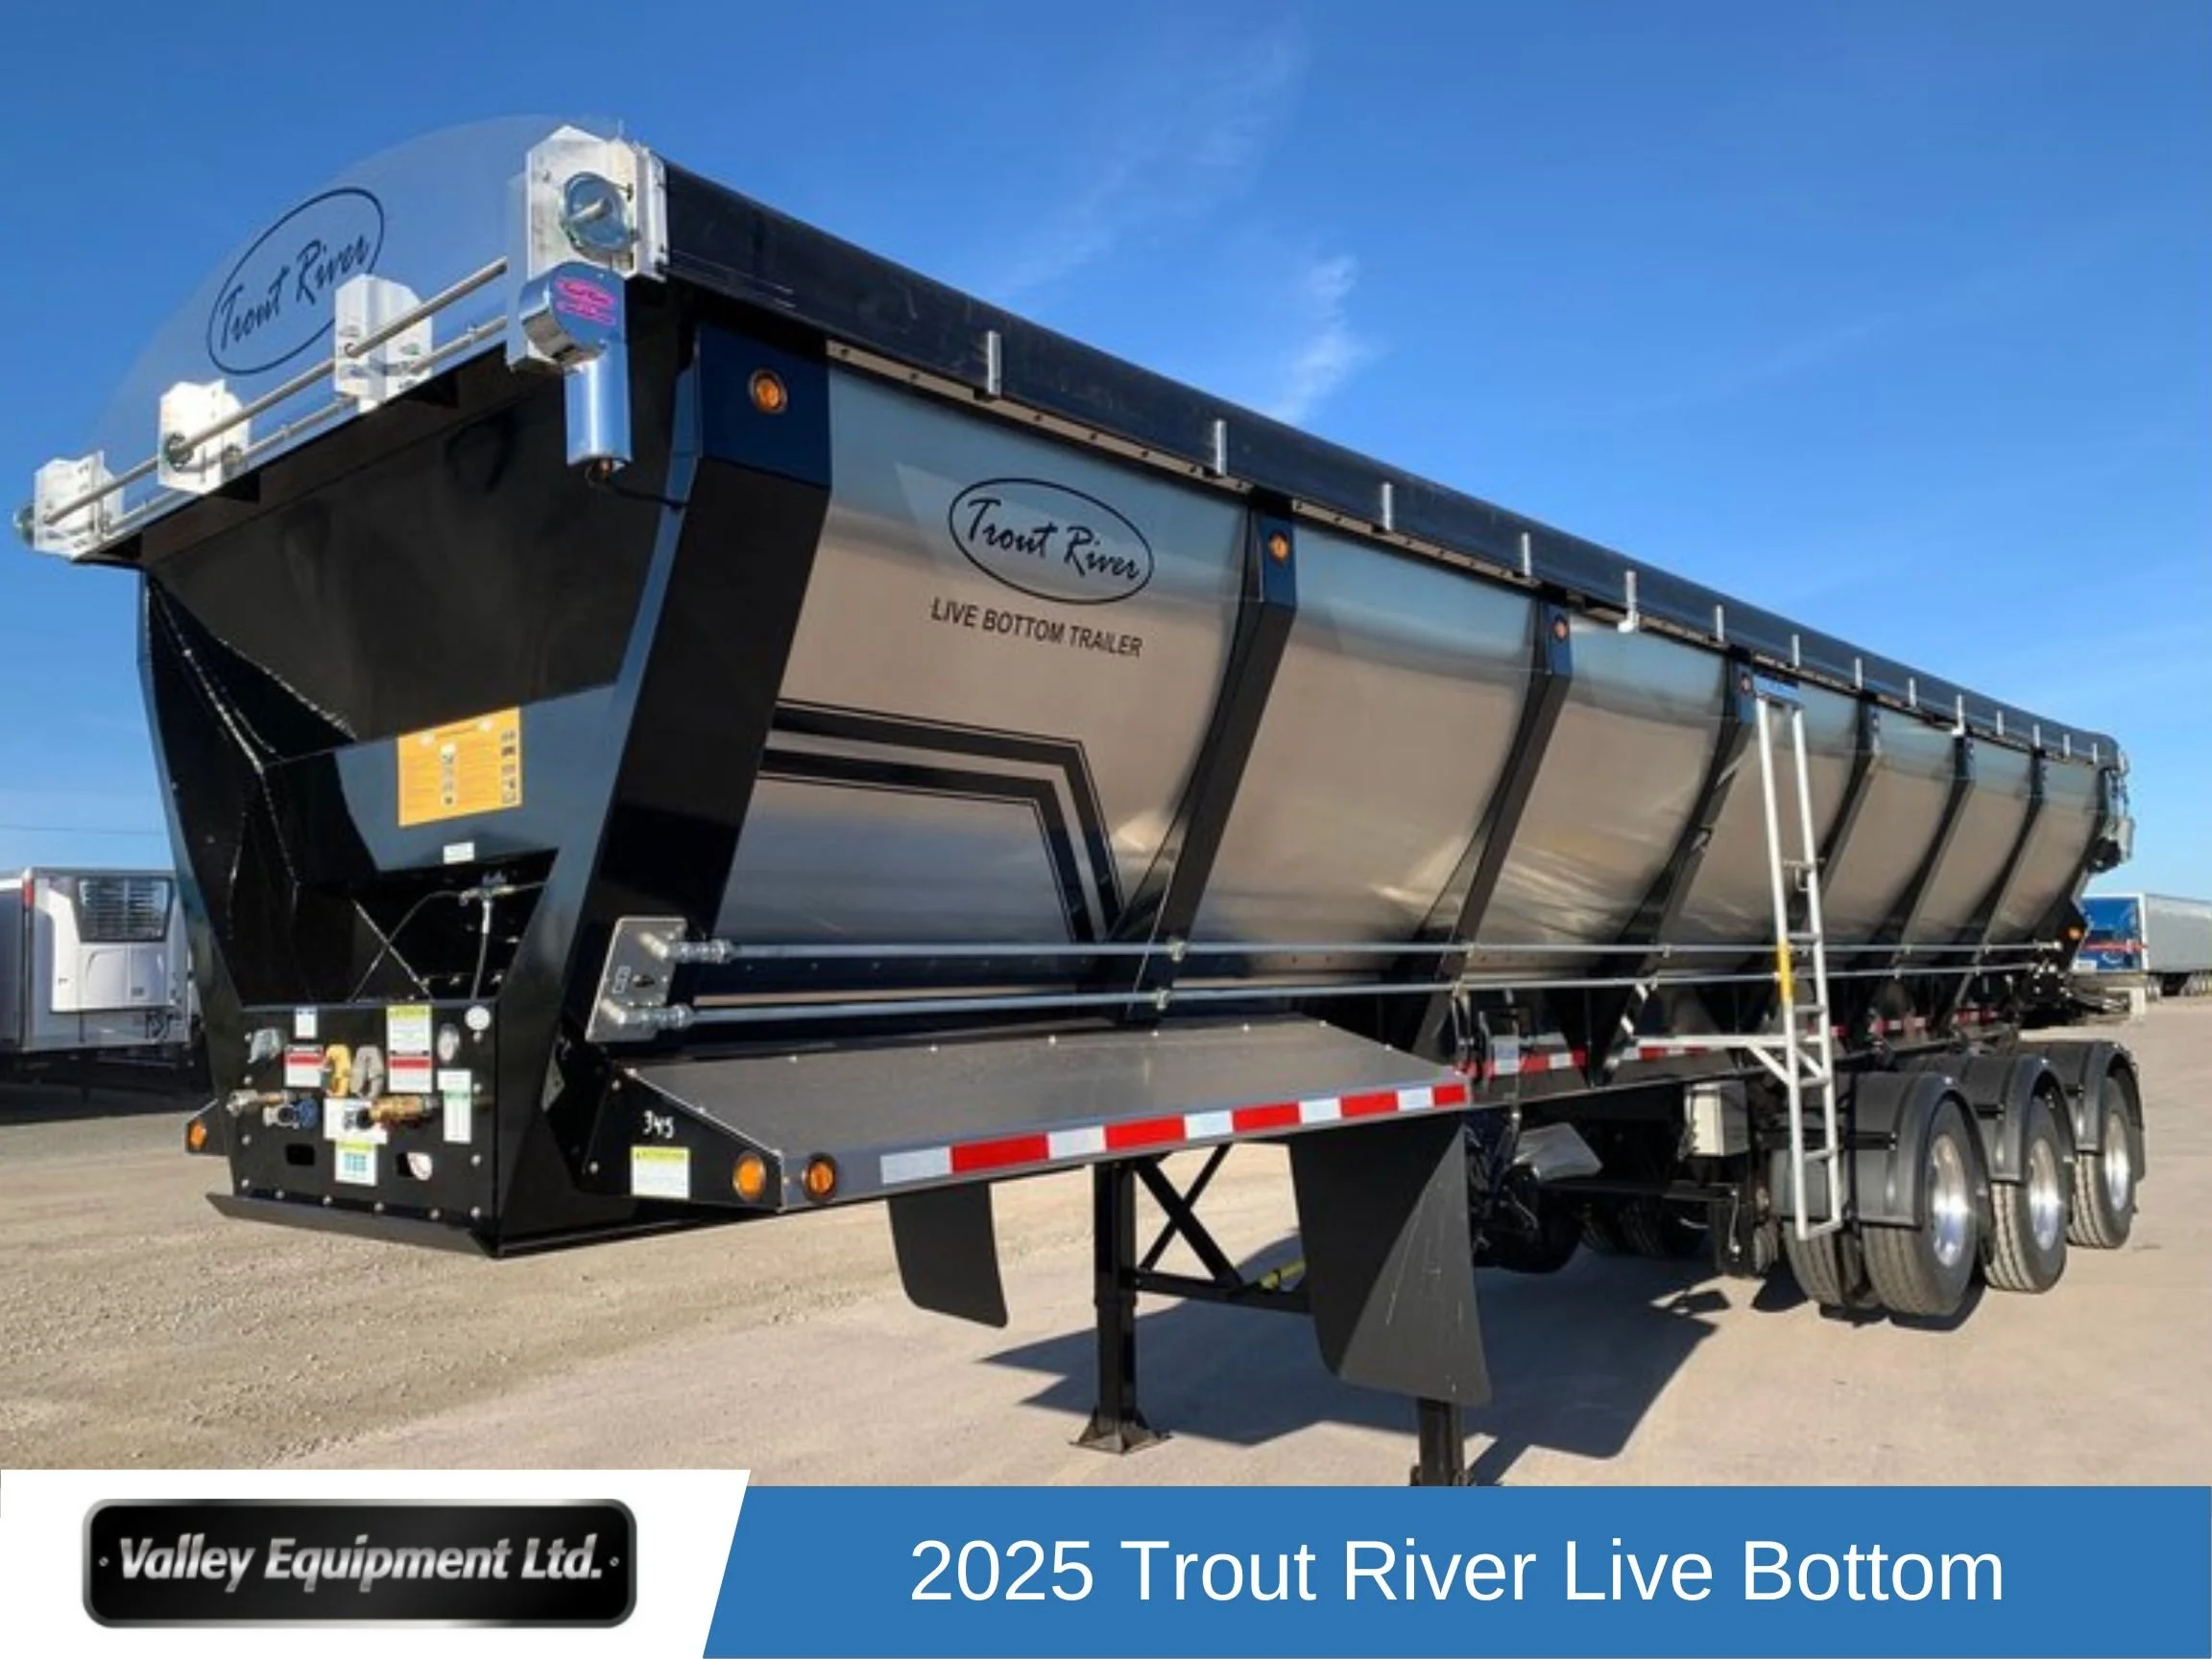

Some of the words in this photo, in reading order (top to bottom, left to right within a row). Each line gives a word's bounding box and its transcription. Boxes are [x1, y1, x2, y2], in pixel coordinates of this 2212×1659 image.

[221, 264, 290, 351] Trout
[297, 235, 370, 304] River
[967, 497, 1057, 557] Trout
[1064, 526, 1140, 579] River
[930, 596, 978, 628] LIVE
[982, 607, 1065, 644] BOTTOM
[1070, 625, 1143, 657] TRAILER
